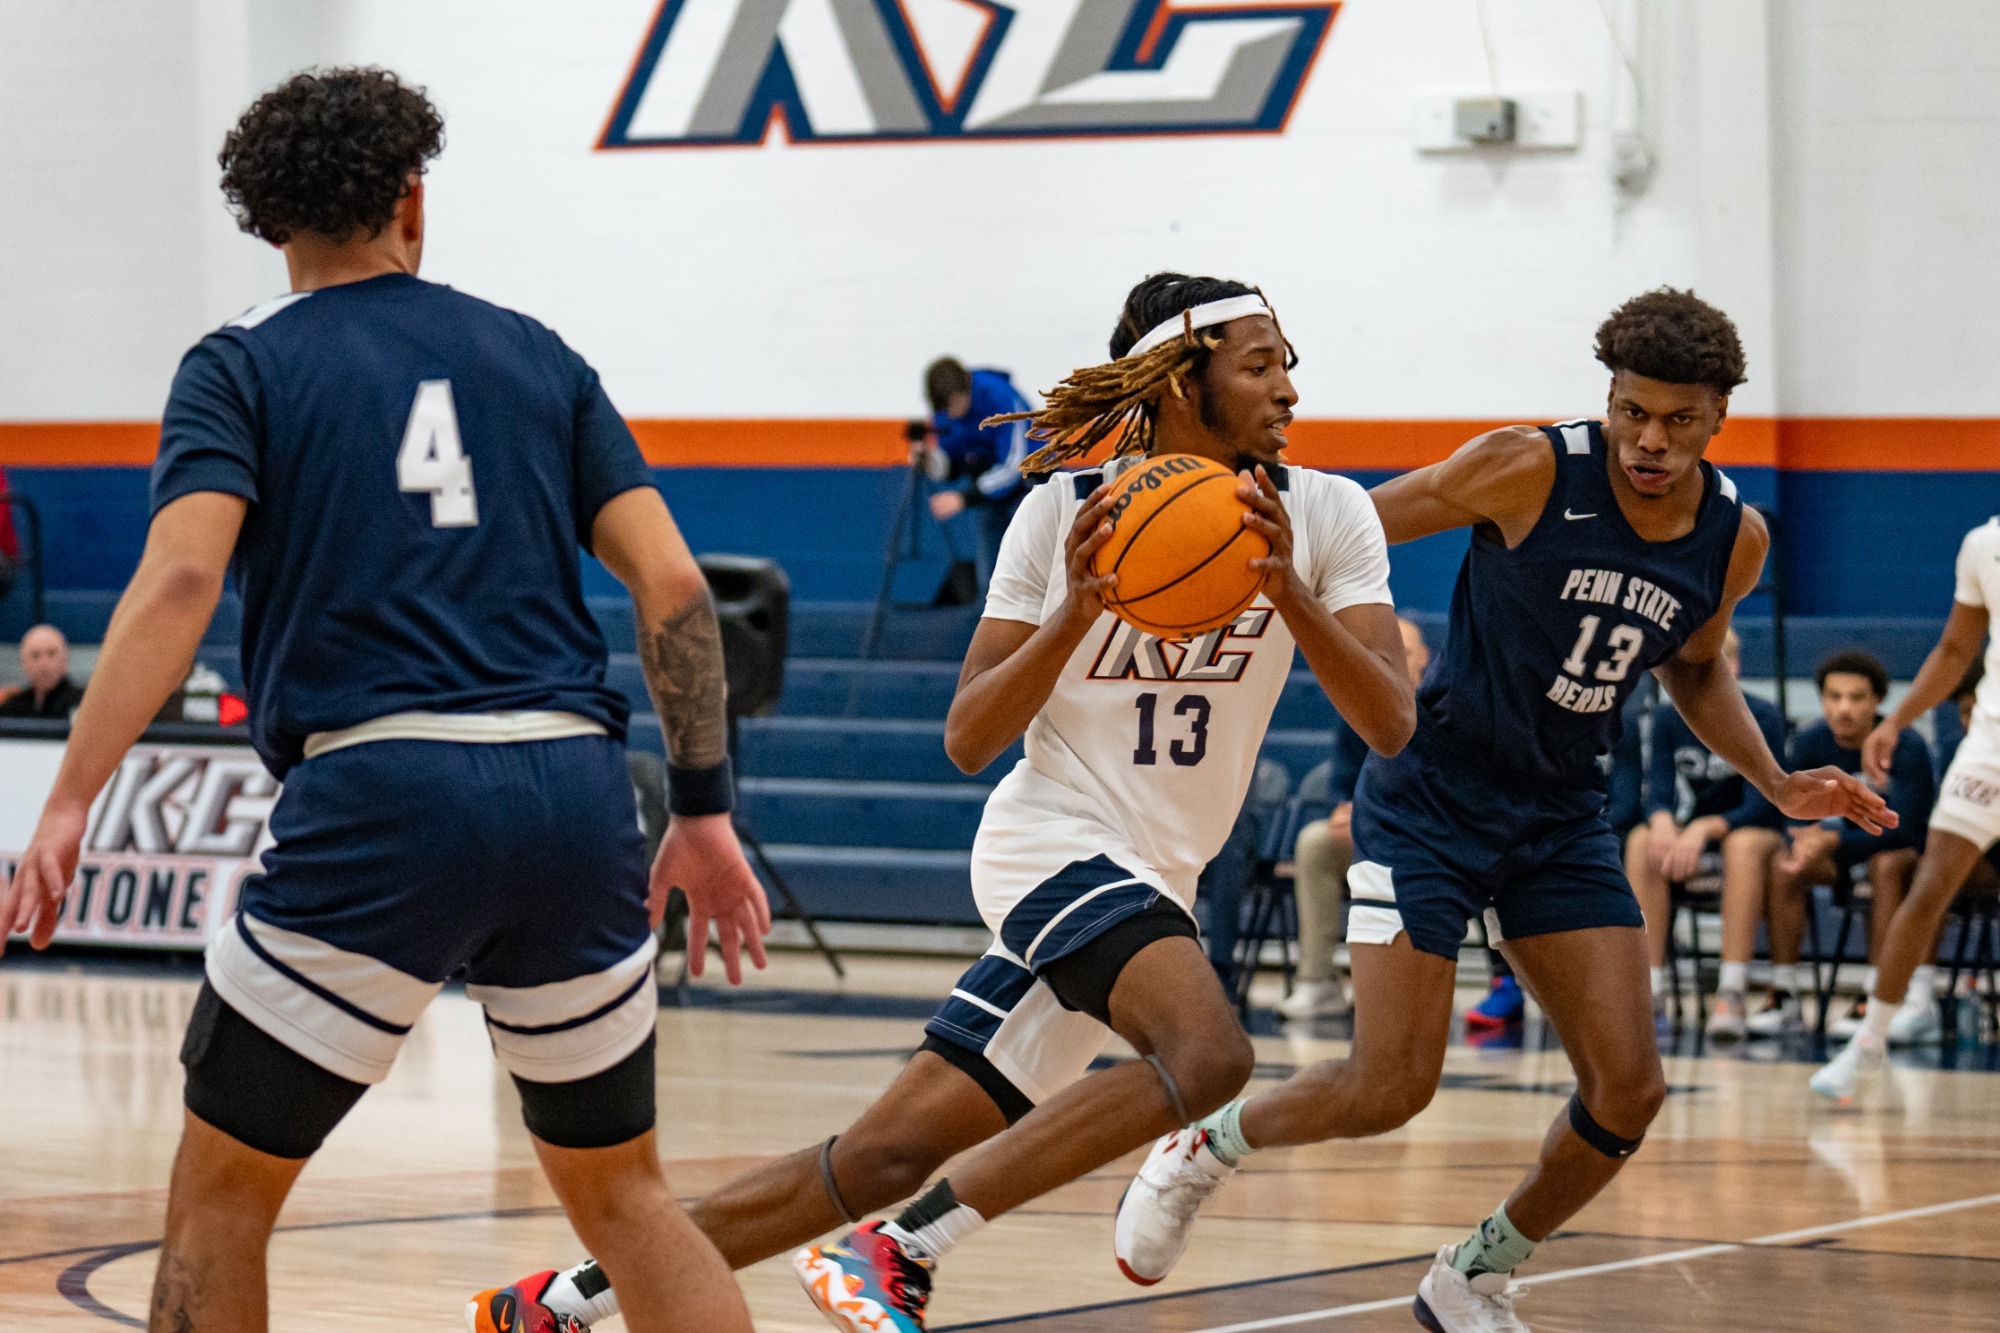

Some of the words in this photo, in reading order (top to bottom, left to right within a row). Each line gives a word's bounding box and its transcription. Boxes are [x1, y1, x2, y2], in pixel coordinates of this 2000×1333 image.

[395, 378, 479, 528] 4
[1560, 569, 1624, 605] PENN
[1622, 576, 1682, 632] STATE
[1562, 614, 1644, 682] 13
[1133, 692, 1211, 766] 13
[1545, 675, 1617, 713] BERKS
[86, 755, 282, 857] KC
